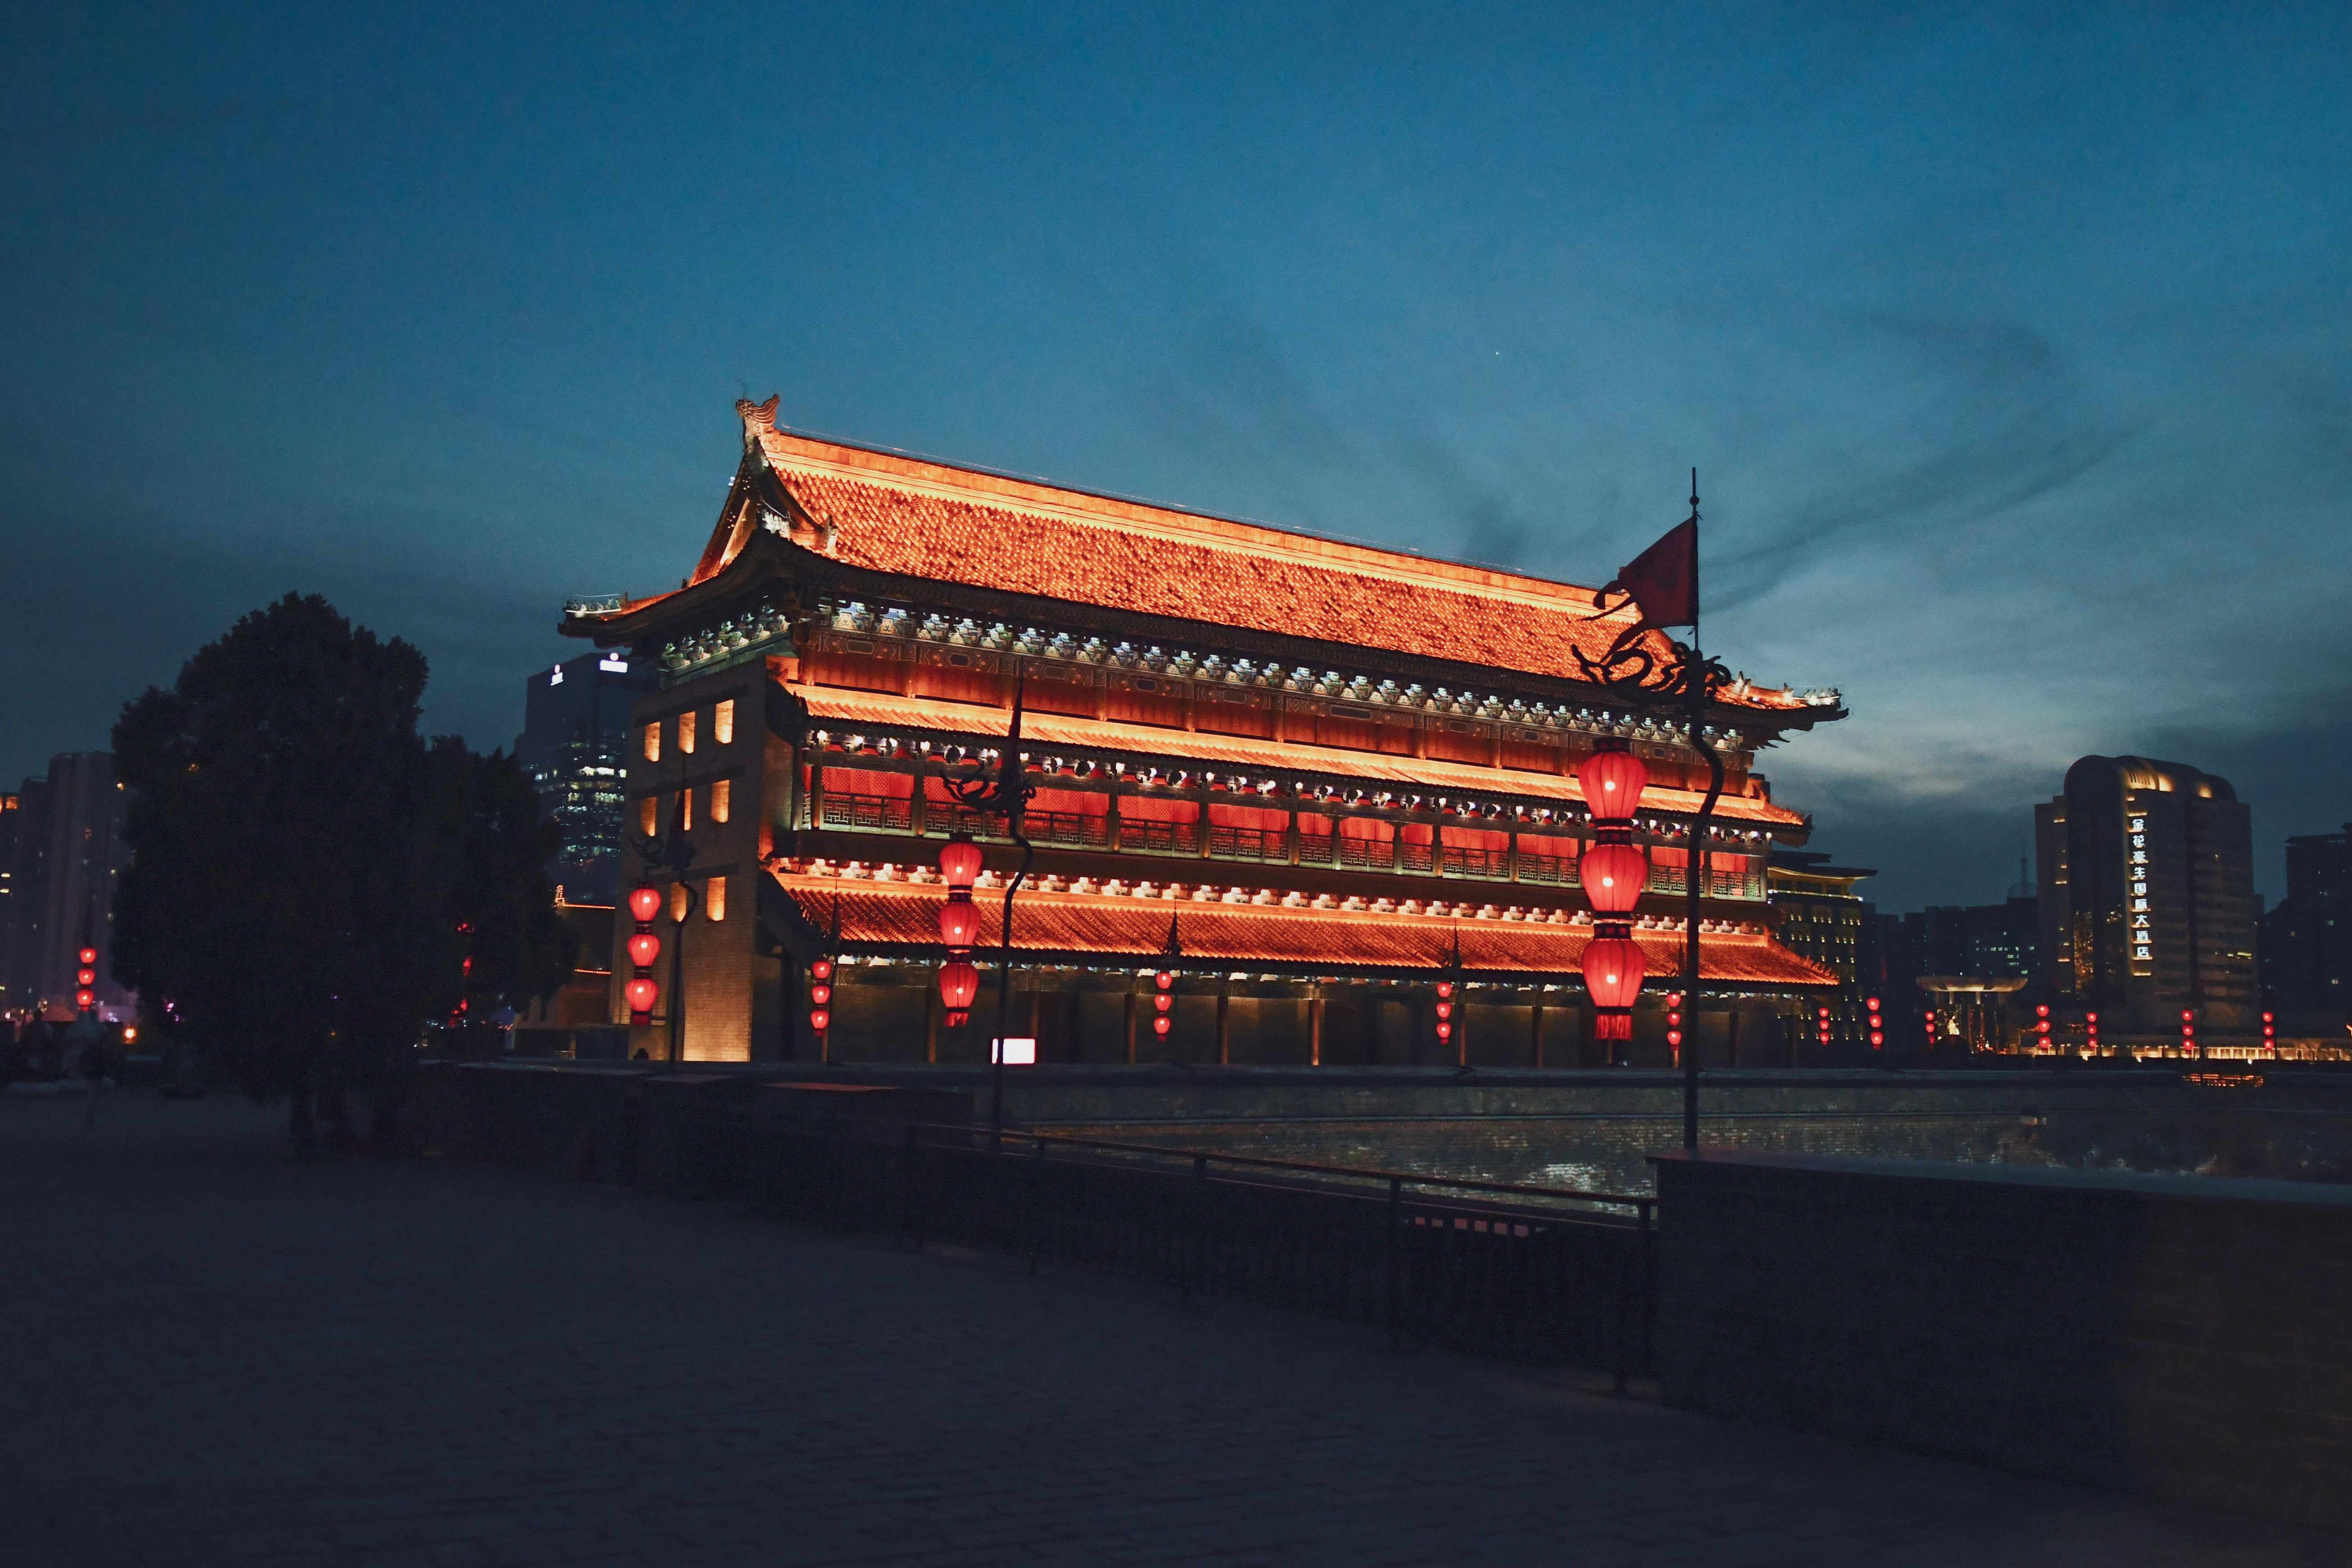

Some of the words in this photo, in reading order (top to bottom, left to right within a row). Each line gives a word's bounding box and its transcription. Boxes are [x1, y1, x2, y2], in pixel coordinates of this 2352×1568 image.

[2132, 818, 2149, 957] 金花豪生国际大酒店
